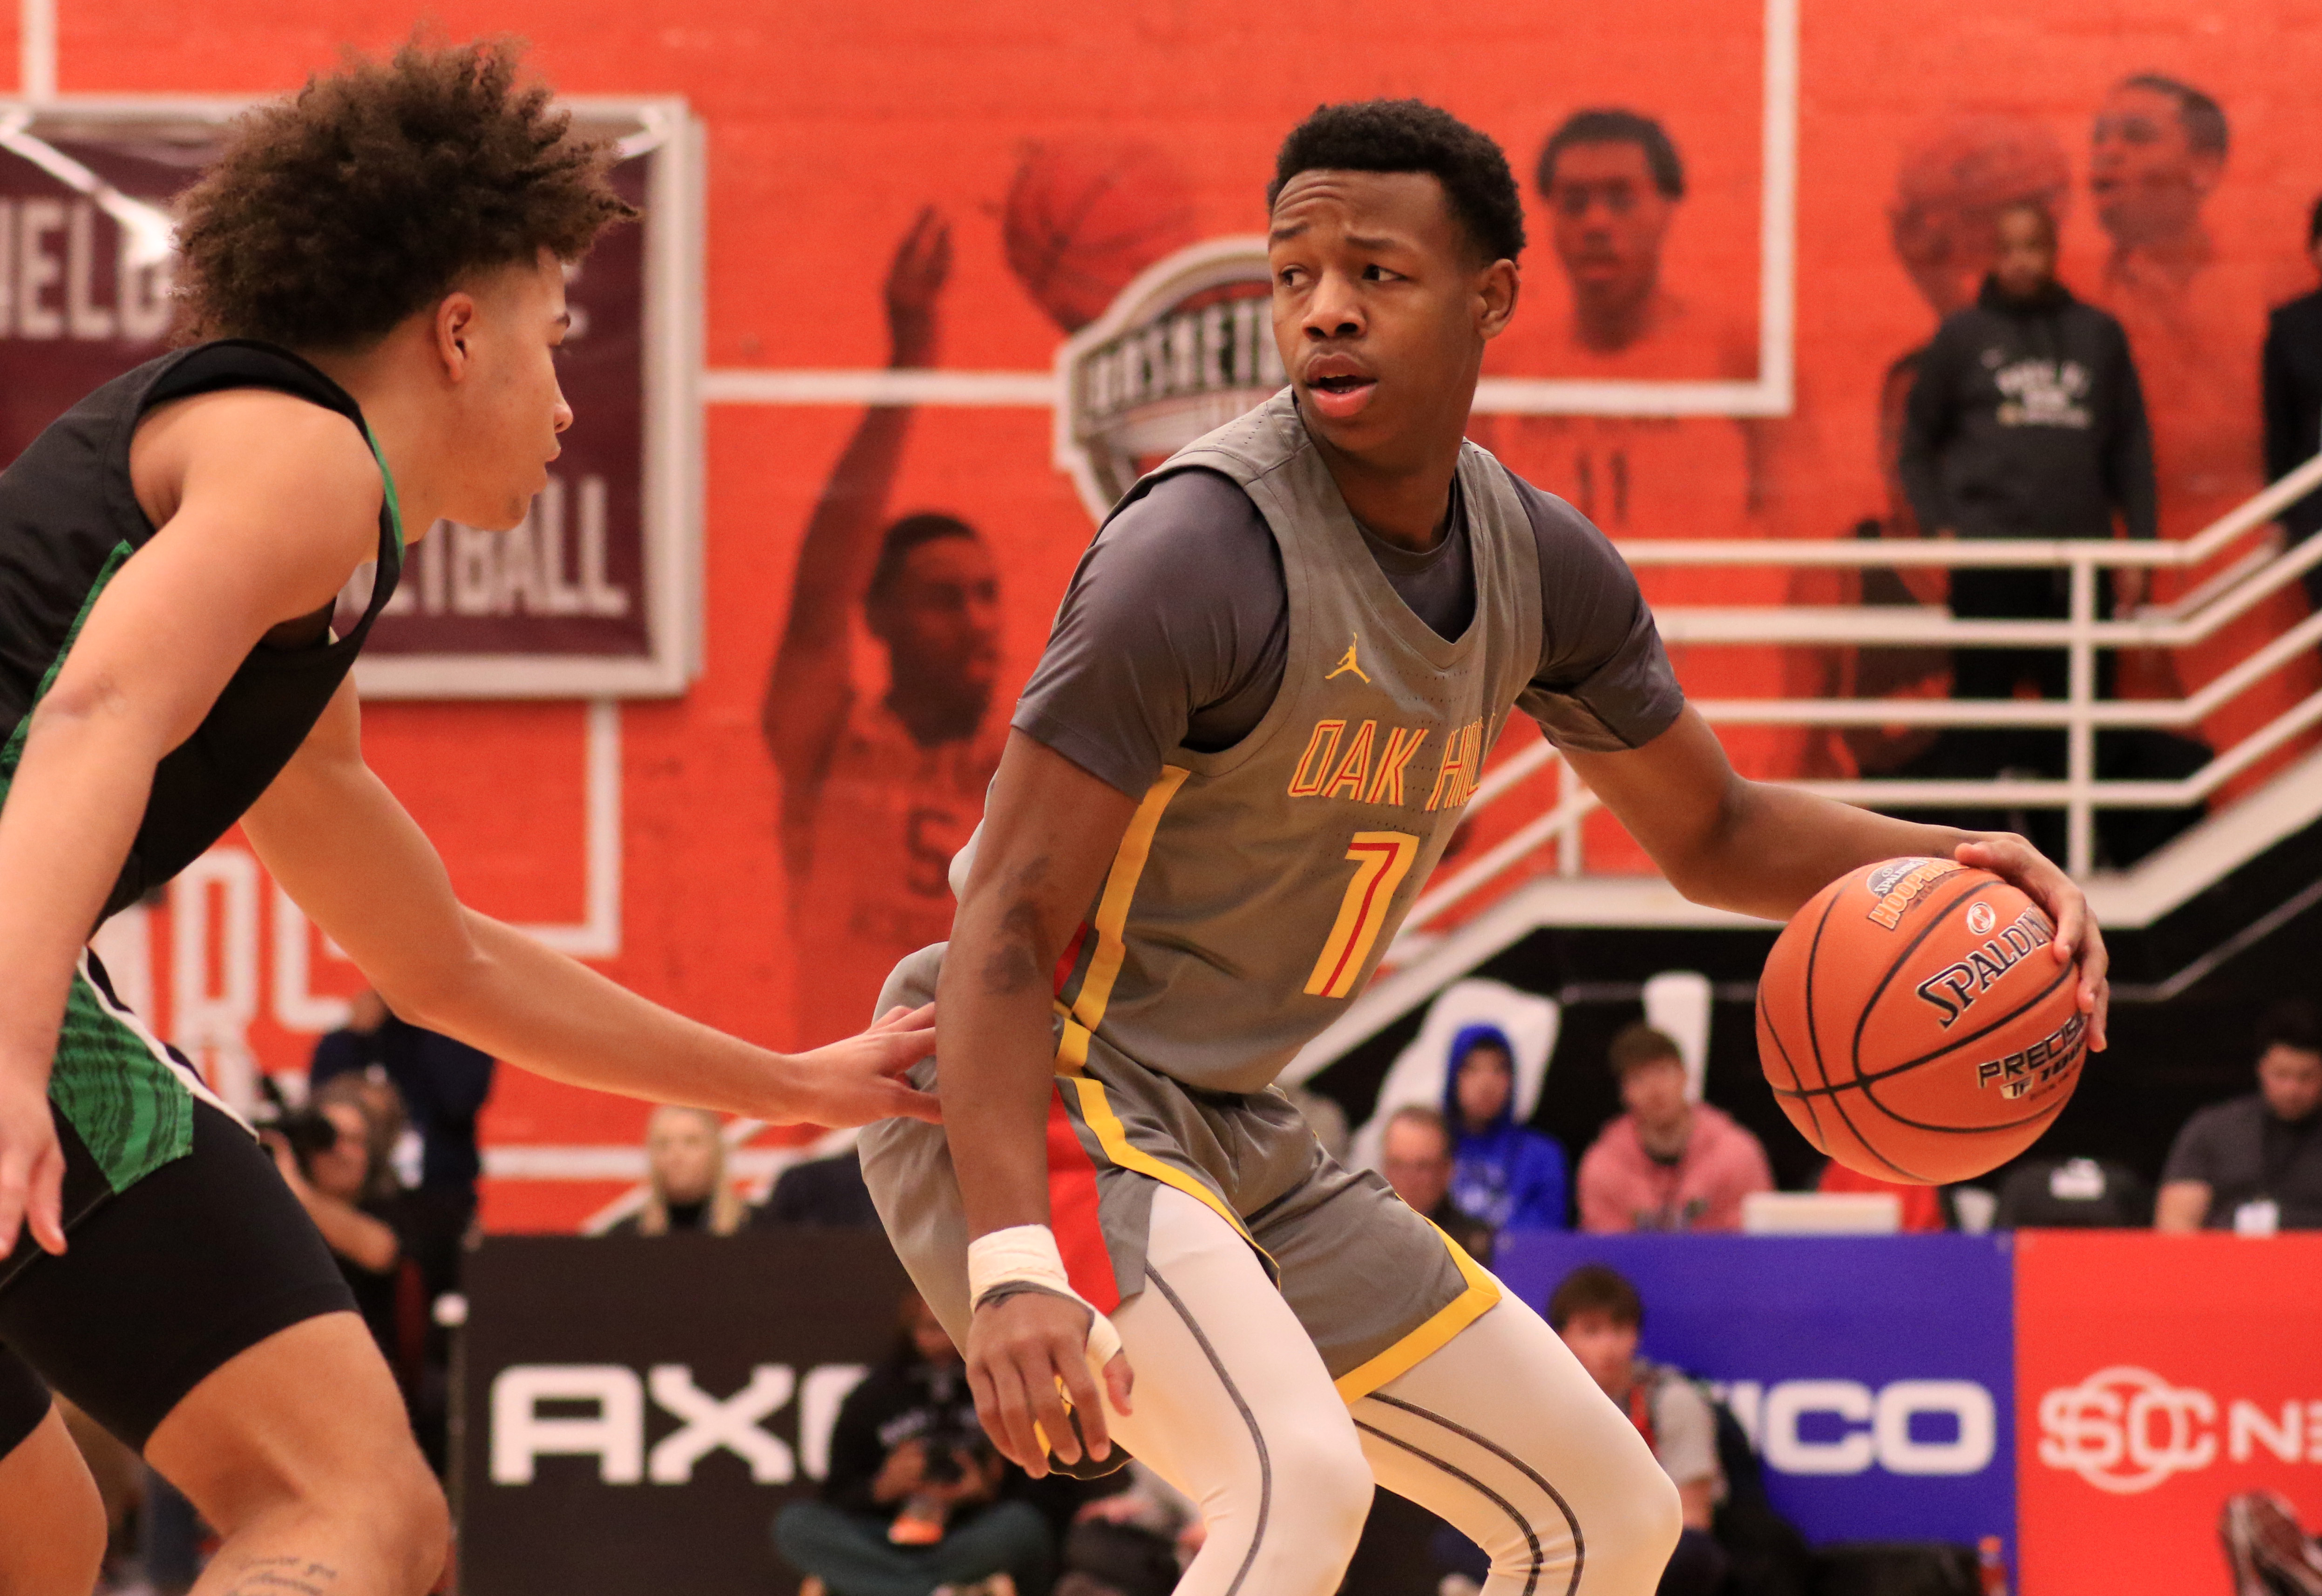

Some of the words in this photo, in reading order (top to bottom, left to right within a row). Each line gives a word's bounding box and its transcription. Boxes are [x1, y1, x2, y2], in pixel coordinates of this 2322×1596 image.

[1288, 719, 1429, 806] OAK
[1425, 711, 1495, 812] HIL
[1304, 831, 1420, 999] 7
[1915, 902, 2056, 1031] SPALDIN
